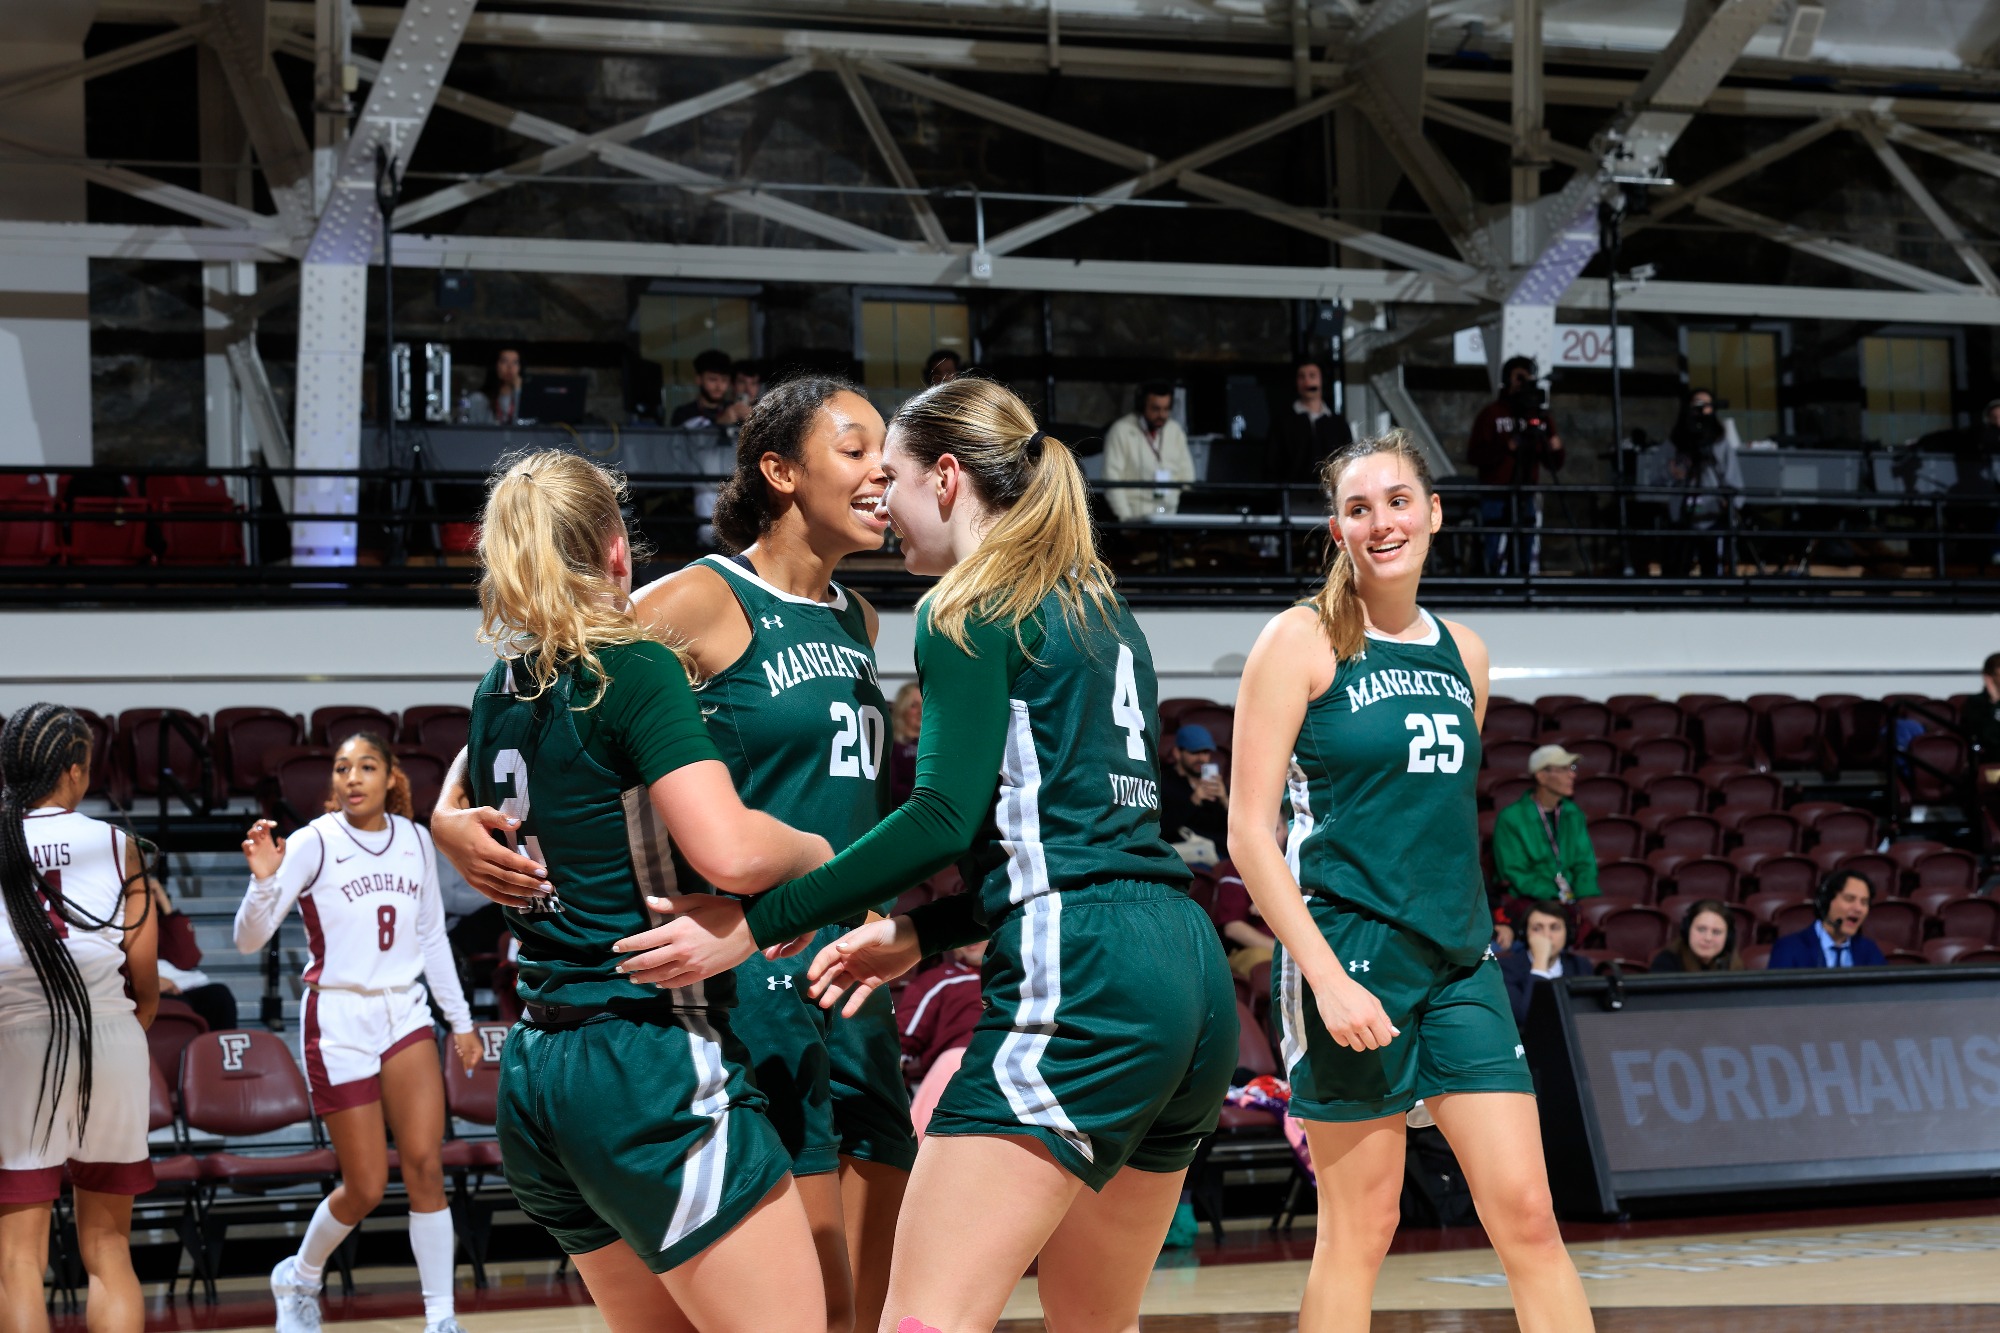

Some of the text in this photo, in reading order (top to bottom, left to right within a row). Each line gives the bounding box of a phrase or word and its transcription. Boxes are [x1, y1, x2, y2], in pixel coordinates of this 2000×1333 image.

[1112, 642, 1147, 762] 4
[829, 701, 885, 780] 20
[1404, 713, 1464, 774] 25
[1108, 772, 1158, 811] YOUNG
[33, 843, 71, 869] AVIS
[341, 873, 419, 902] FORDHAM
[377, 905, 396, 952] 8
[219, 1033, 251, 1072] F
[479, 1026, 509, 1062] F
